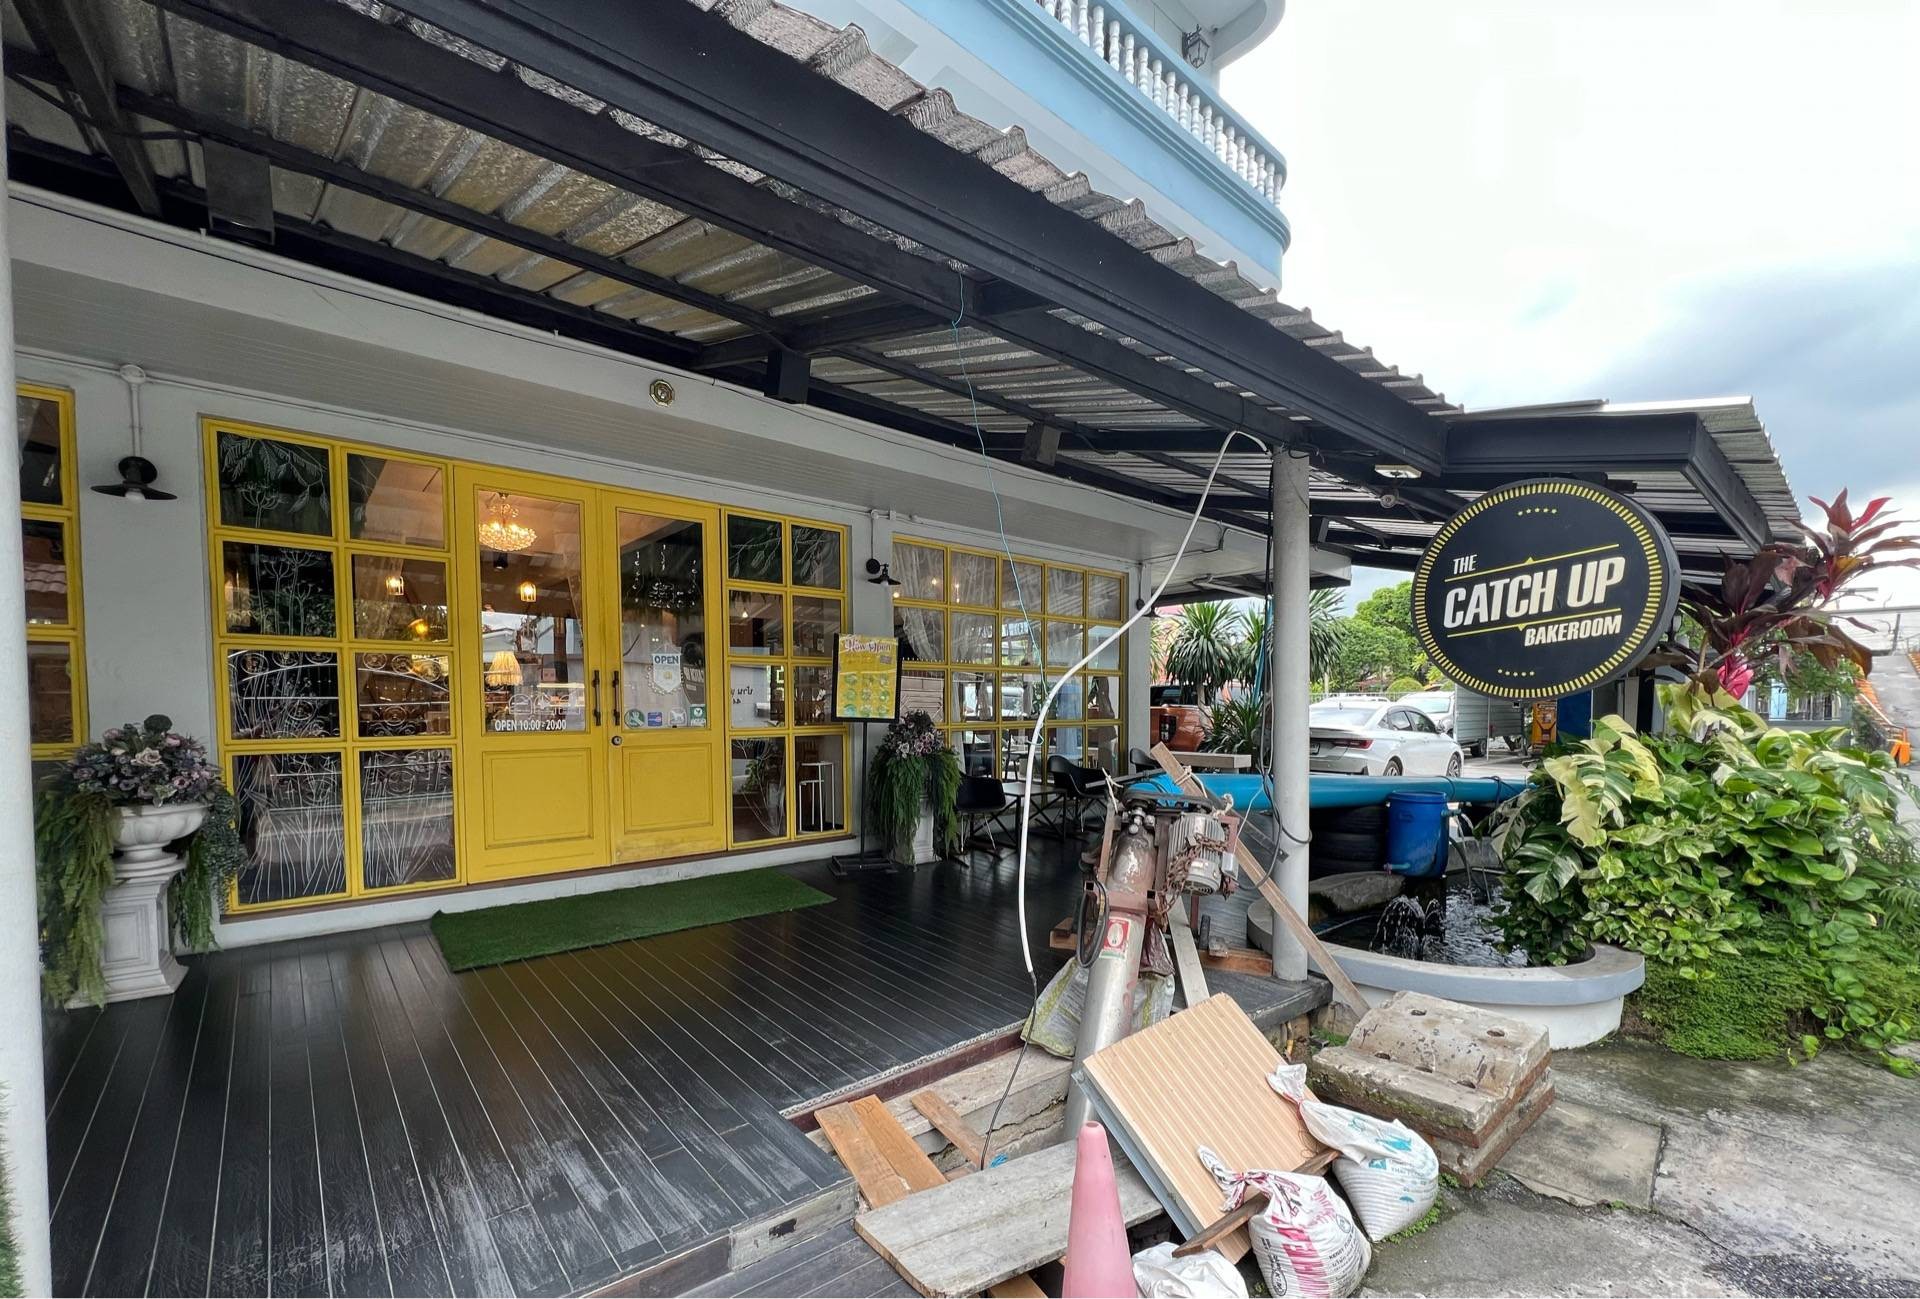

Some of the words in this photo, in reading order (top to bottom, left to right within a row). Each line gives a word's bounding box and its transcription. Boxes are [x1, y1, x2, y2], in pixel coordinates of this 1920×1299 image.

[1453, 554, 1477, 575] THE
[1443, 568, 1558, 629] CATCH
[1566, 556, 1626, 608] UP
[1524, 615, 1623, 647] BAKEROOM
[654, 655, 679, 664] OPEN
[494, 719, 517, 732] OPEN
